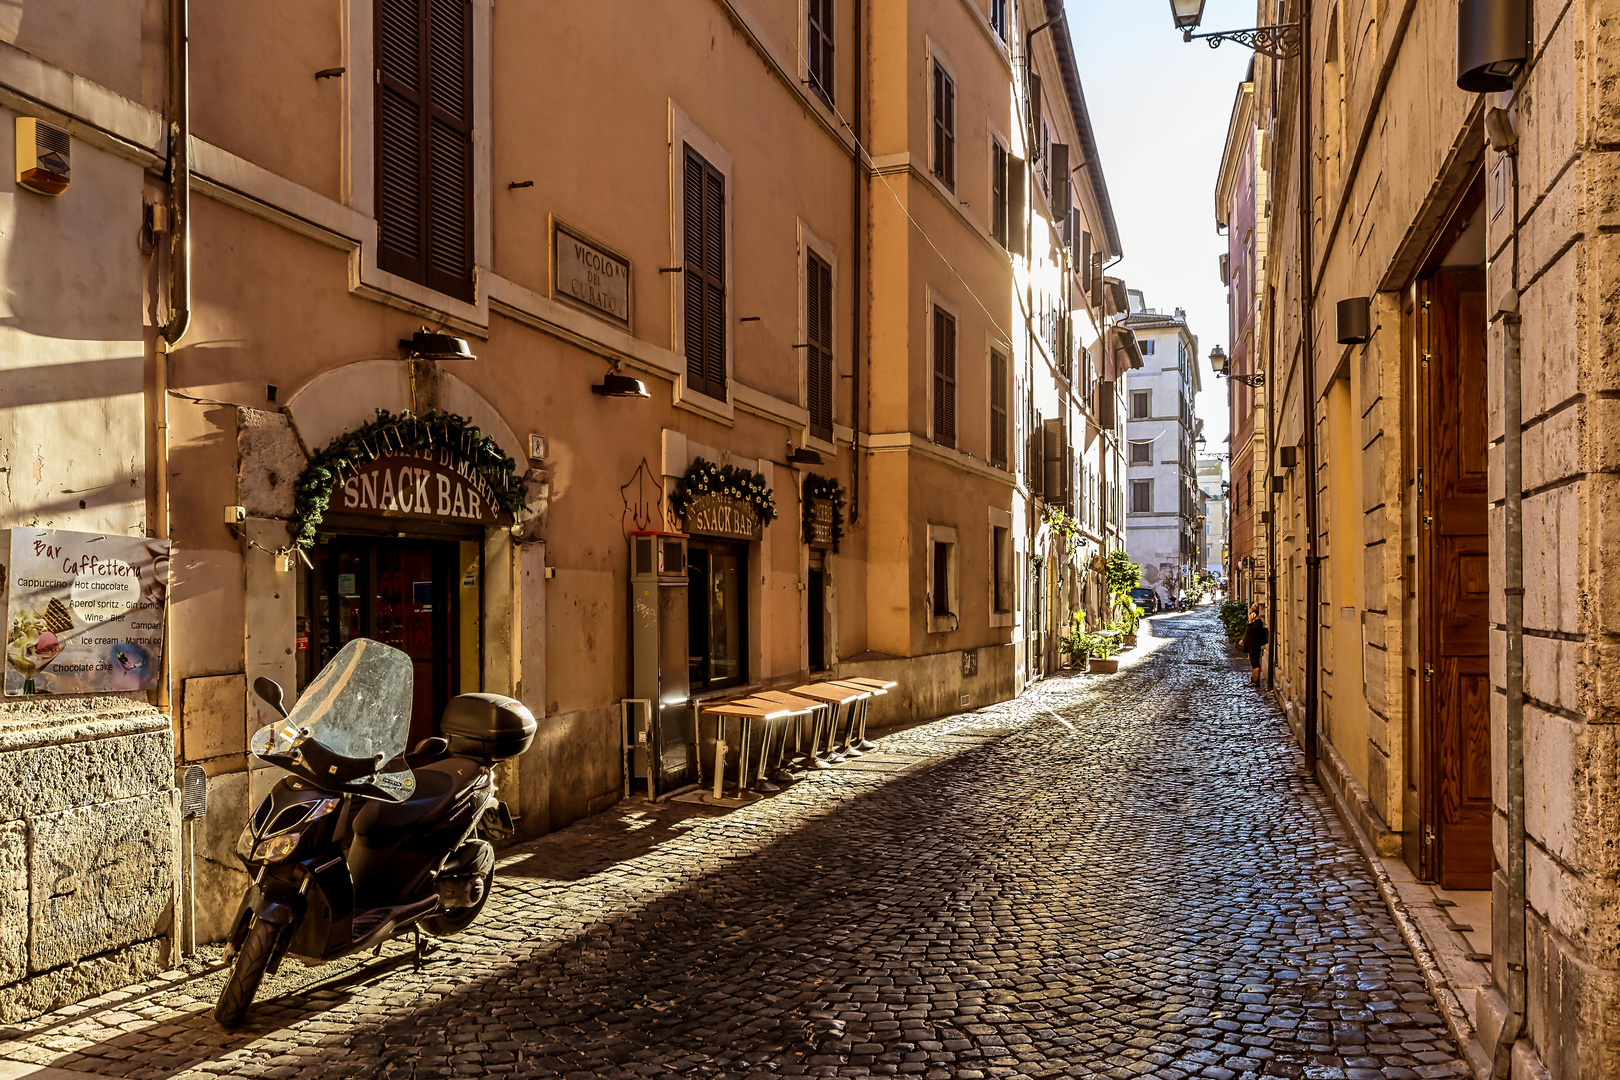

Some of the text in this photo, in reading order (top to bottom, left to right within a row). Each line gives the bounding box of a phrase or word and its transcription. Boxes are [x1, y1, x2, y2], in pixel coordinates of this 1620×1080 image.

[575, 244, 613, 277] VICOLO
[587, 271, 601, 287] DEL
[571, 278, 617, 312] CURATO
[535, 440, 541, 455] 8
[439, 446, 454, 471] DI
[456, 456, 500, 520] MARTE
[344, 466, 483, 520] SNACK BAR
[696, 505, 732, 533] SNACK
[733, 509, 753, 536] BAR
[33, 539, 62, 560] Bar
[62, 554, 142, 579] Caffetteria
[17, 577, 129, 591] Cappuccino Hot chocolate
[69, 599, 159, 610] Aperol spritz Gin tonic
[84, 613, 126, 622] Wine Bier
[131, 621, 161, 631] Campari
[81, 636, 92, 645] Ice
[125, 636, 152, 645] Martini
[52, 663, 113, 673] Chocolate cake
